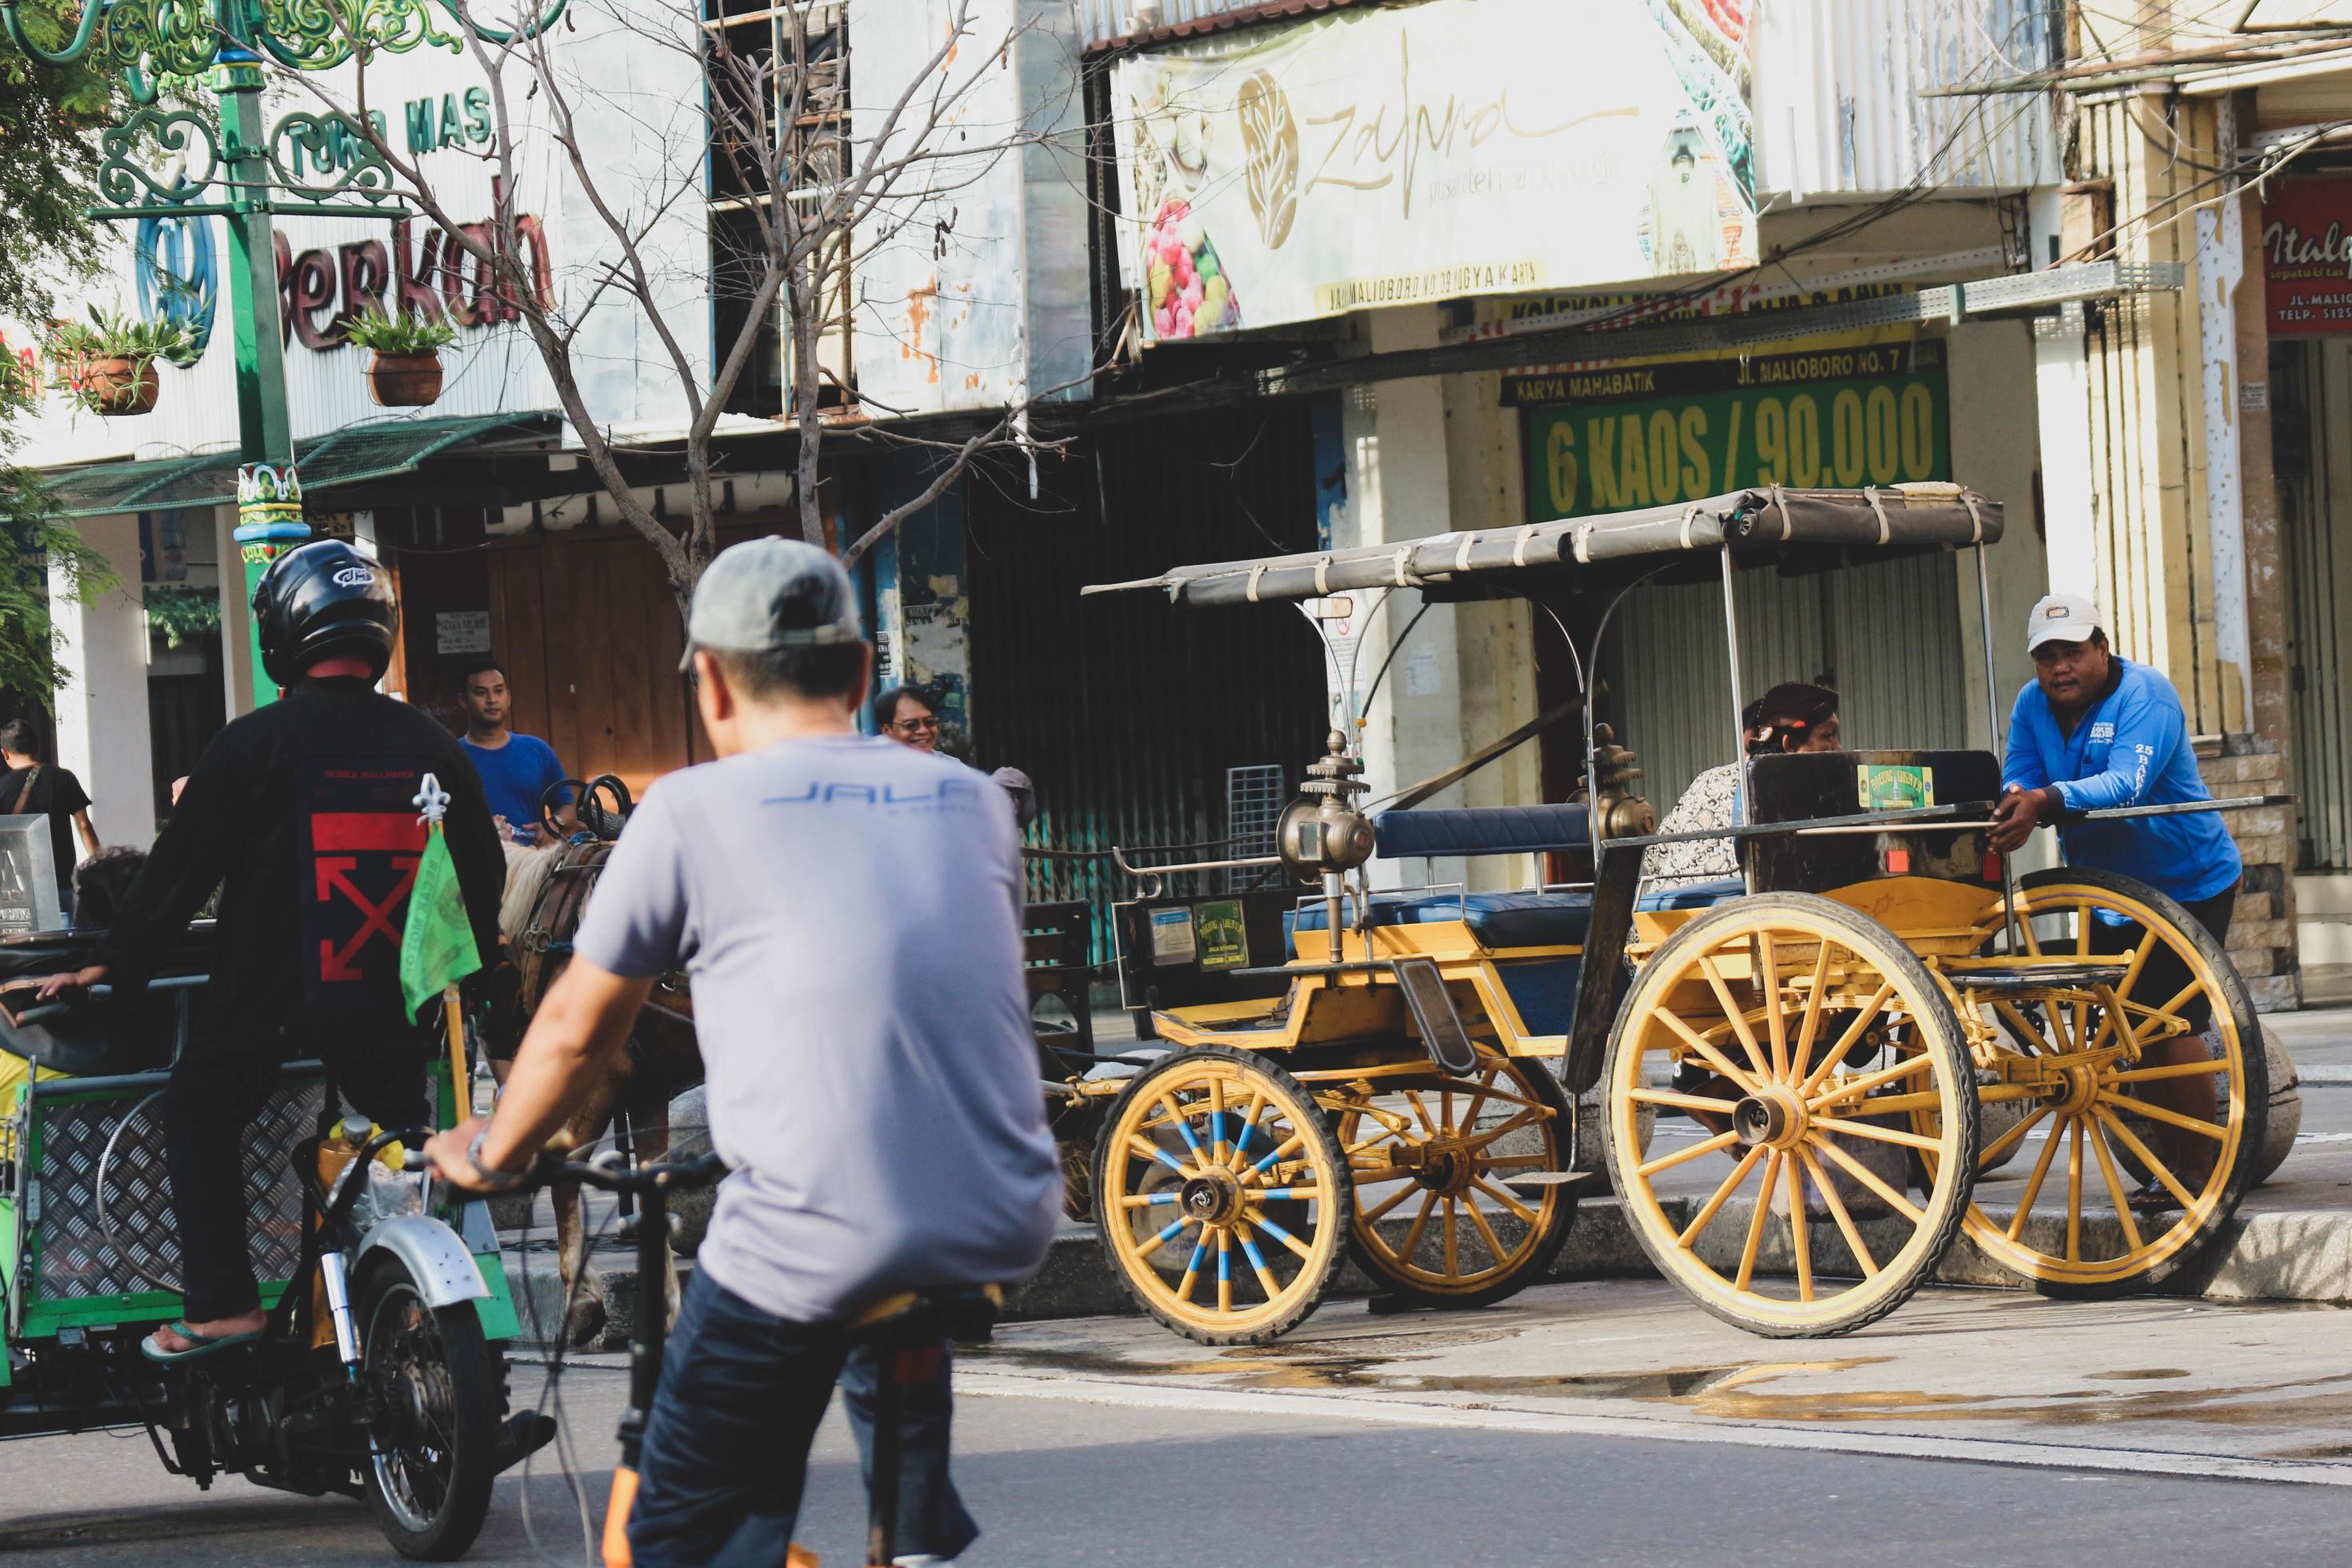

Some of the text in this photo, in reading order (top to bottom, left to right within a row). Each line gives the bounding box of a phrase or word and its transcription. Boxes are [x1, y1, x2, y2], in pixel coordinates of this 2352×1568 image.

[405, 87, 490, 154] MAS
[2326, 268, 2344, 277] tas
[2278, 309, 2316, 321] TELP.
[1517, 378, 1565, 401] KARYA
[1570, 370, 1654, 398] MAHABATIK
[1760, 354, 1853, 382] MALIOBORO
[1857, 350, 1884, 374] NO.
[1889, 349, 1900, 371] 7
[1546, 384, 1933, 514] 6 KAOS / 90.000
[2134, 743, 2154, 755] 25
